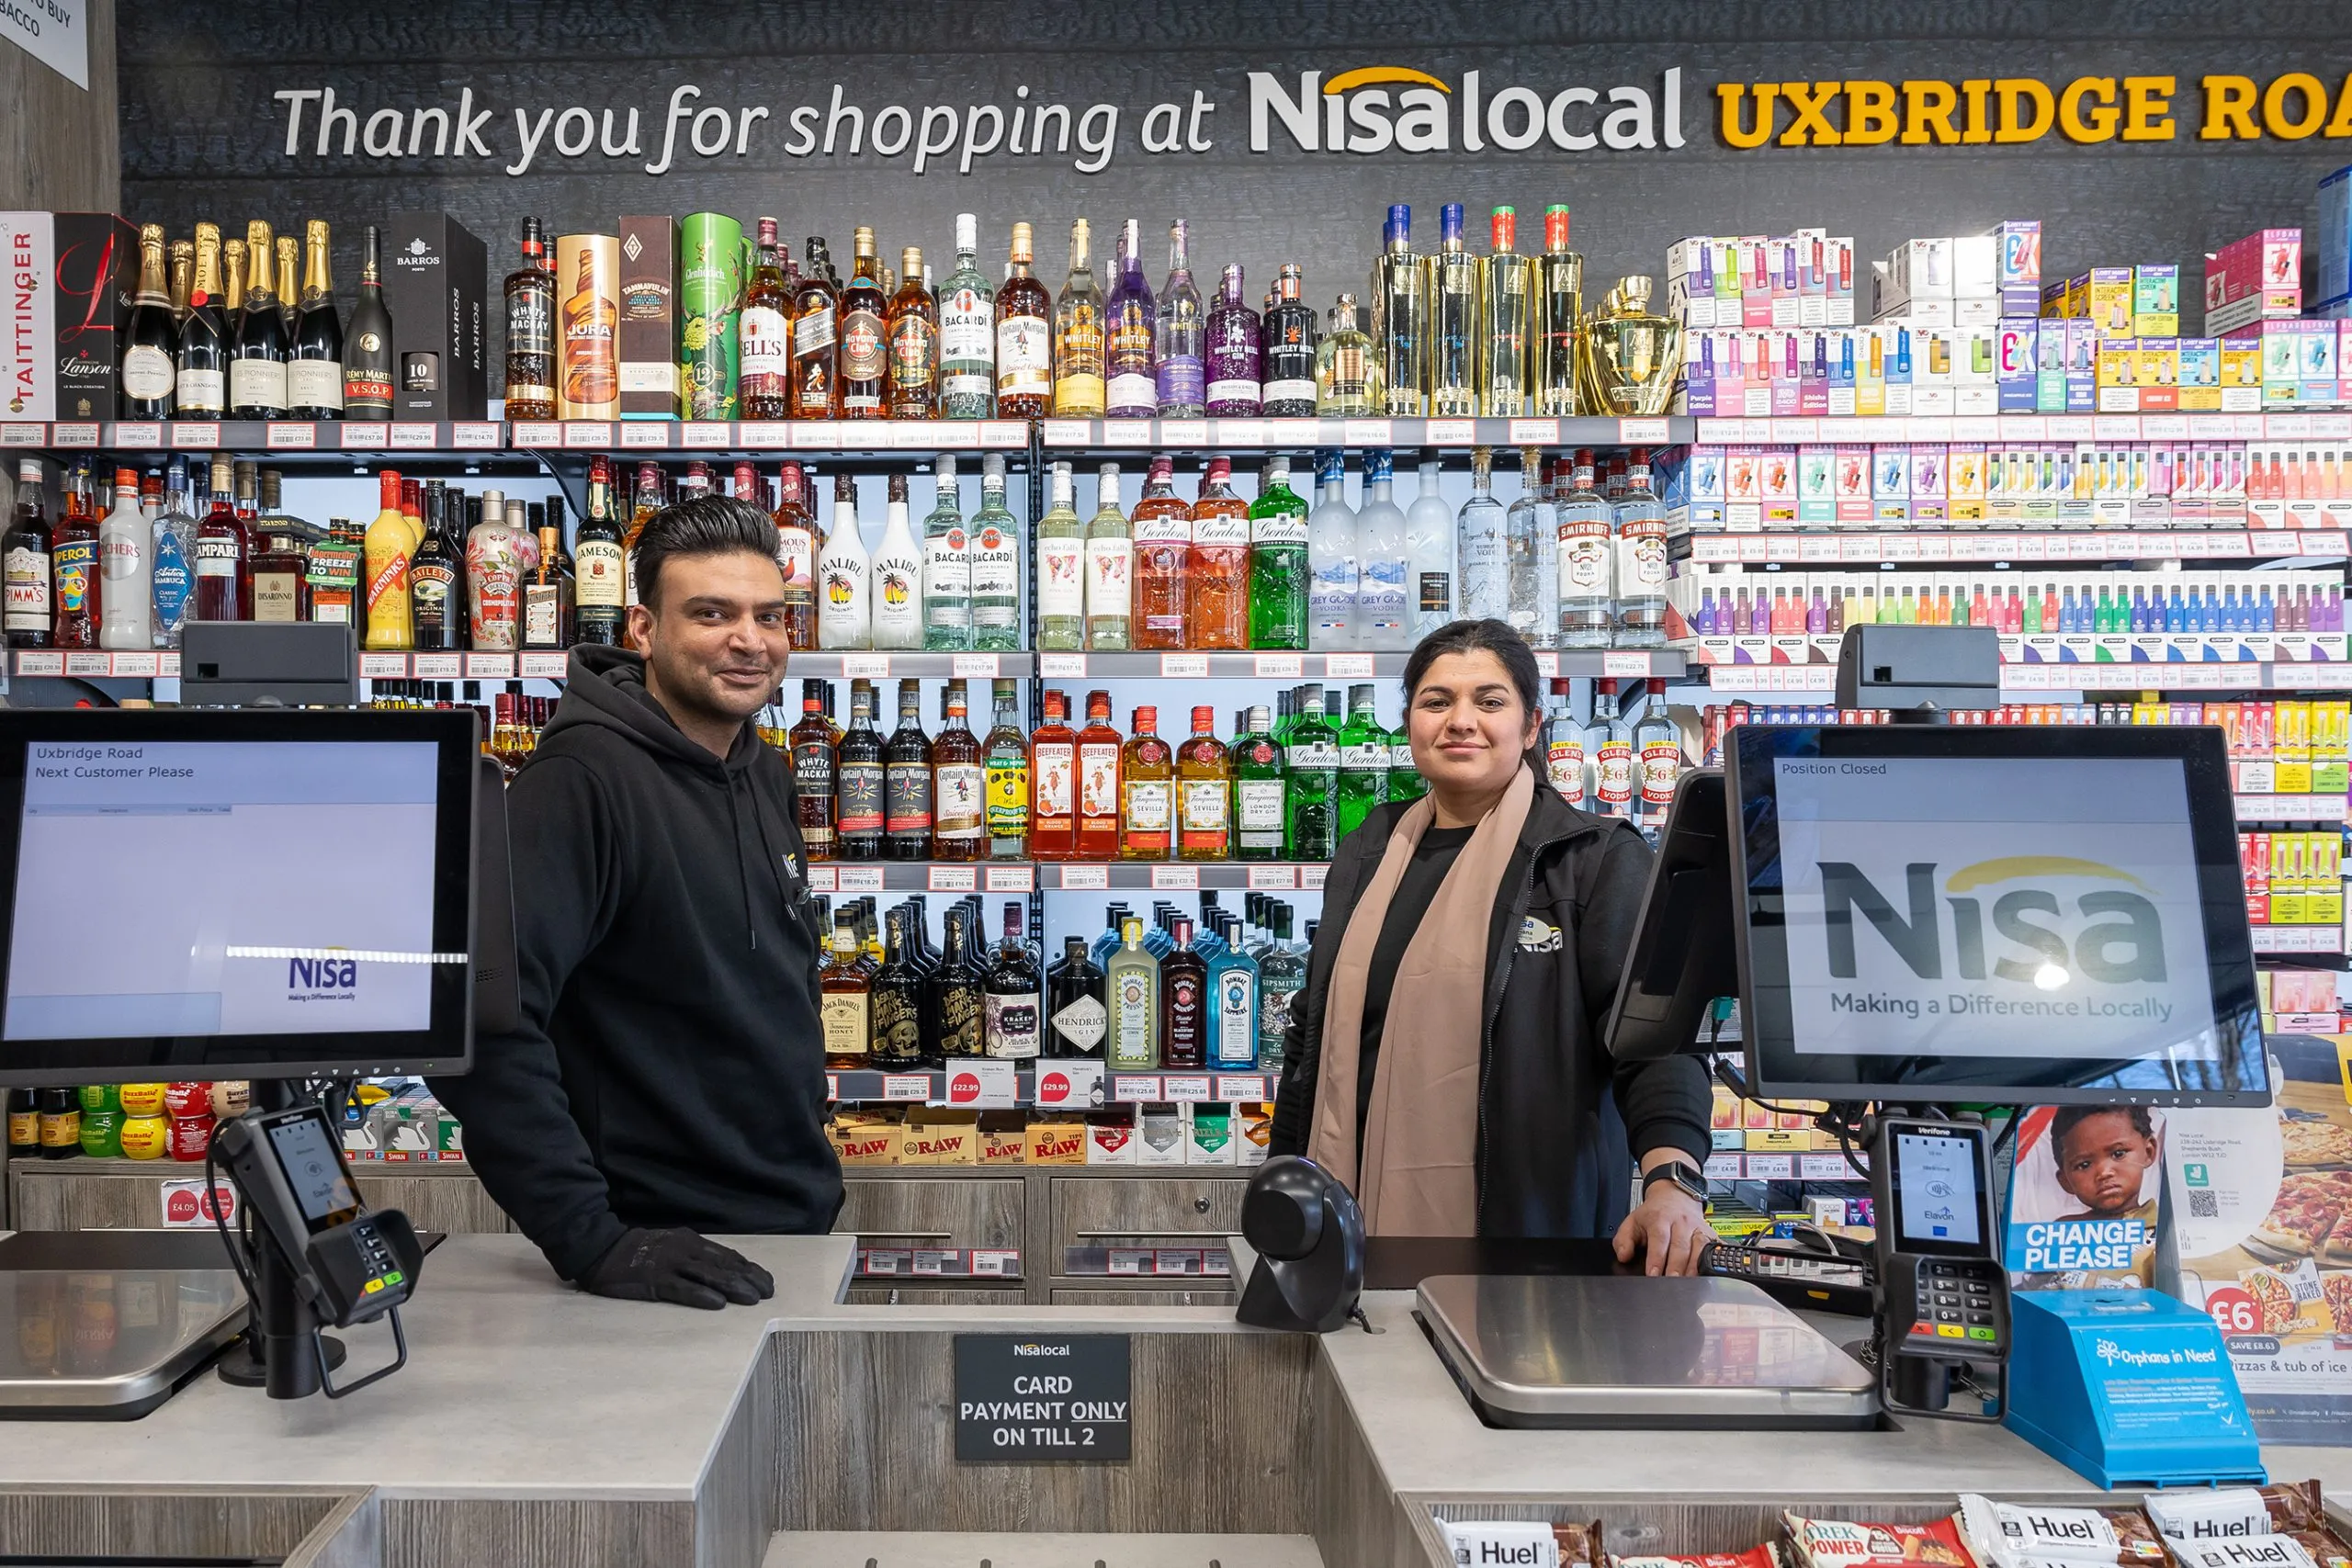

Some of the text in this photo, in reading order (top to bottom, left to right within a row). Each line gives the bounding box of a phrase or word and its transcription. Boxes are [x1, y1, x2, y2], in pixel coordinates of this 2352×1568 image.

[48, 6, 71, 28] BUY
[274, 86, 492, 158] Thank
[505, 107, 641, 176] you
[645, 85, 769, 175] for
[785, 84, 1119, 175] shopping
[1141, 90, 1215, 153] at
[1717, 75, 2176, 149] UXBRIDGE
[397, 256, 440, 266] BARROS
[622, 282, 670, 298] TAMNAVULIN
[14, 232, 35, 401] TAITTINGER
[511, 306, 548, 321] WHYTE
[510, 320, 548, 332] MACKAY
[567, 324, 612, 337] JURA
[845, 333, 879, 345] Havana
[1064, 333, 1102, 345] WHITLEY
[1113, 333, 1150, 345] WHITLEY
[741, 338, 782, 358] BELL'S
[851, 342, 871, 354] Club
[1215, 345, 1240, 355] WHITLEY
[1269, 345, 1294, 354] WHITLEY
[59, 356, 111, 378] Lanson
[410, 365, 428, 378] 10
[695, 367, 710, 380] 12
[1690, 394, 1713, 403] Purple
[1804, 393, 1826, 401] Shisha
[1804, 401, 1827, 410] Edition
[1560, 525, 1610, 539] SMIRNOFF
[575, 546, 622, 561] JAMESON
[311, 558, 354, 568] FREEZE
[820, 557, 864, 579] MALIBU
[876, 557, 919, 579] MALIBU
[311, 566, 352, 575] TO WIN
[411, 566, 455, 582] BAILEYS
[487, 572, 511, 582] COPPA
[367, 556, 407, 608] WARNINKS
[6, 585, 45, 604] PIMM'S
[258, 593, 293, 602] DISARONNO
[1309, 595, 1357, 605] GREY GOOSE
[1362, 595, 1380, 605] GREY
[482, 599, 515, 607] COSMOPOLITAN
[828, 604, 854, 614] ORIGINAL
[37, 747, 143, 761] Uxbridge Road
[1037, 747, 1072, 759] BEEFEATER
[1081, 747, 1116, 759] BEEFEATER
[1550, 749, 1583, 760] GLEN'S
[1600, 749, 1632, 760] GLEN'S
[1644, 749, 1679, 760] GLEN'S
[797, 757, 830, 770] WHYTE
[1782, 761, 1887, 776] Position Closed
[35, 766, 194, 778] Next Customer Please
[797, 769, 831, 780] MACKAY
[839, 768, 884, 781] Captain Morgan
[1603, 792, 1631, 802] VODKA
[1136, 805, 1163, 813] SEVILLA
[1193, 805, 1220, 813] SEVILLA
[1815, 856, 2167, 985] Nisa
[289, 956, 356, 988] Nisa
[1123, 977, 1144, 990] BOMBAY
[1225, 974, 1249, 987] BOMBAY
[1261, 979, 1305, 987] SIPSMITH
[875, 988, 896, 1007] DEAD
[823, 998, 861, 1013] JACK DANIEL'S
[876, 999, 901, 1017] MAN'S
[1831, 992, 2173, 1023] Making a Difference Locally
[876, 1008, 919, 1029] FINGERS
[1003, 1015, 1034, 1023] KRAKEN
[1078, 1028, 1095, 1036] GIN
[953, 1083, 979, 1093] £22.99
[1043, 1082, 1069, 1092] £29.99
[1069, 1133, 1083, 1141] TIPS
[1918, 1126, 1951, 1138] Verifone
[842, 1139, 889, 1157] RAW
[918, 1136, 963, 1156] RAW
[985, 1142, 1023, 1159] RAW
[1035, 1138, 1082, 1157] RAW
[388, 1152, 406, 1160] SWAN
[442, 1152, 460, 1160] SWAN
[172, 1202, 195, 1213] £4.05
[1924, 1210, 1955, 1223] Elavon
[2026, 1221, 2143, 1247] CHANGE
[2025, 1245, 2130, 1271] PLEASE
[2295, 1280, 2319, 1294] STONE
[2298, 1289, 2321, 1301] BAKED
[2212, 1301, 2255, 1332] £6
[2230, 1341, 2276, 1352] SAVE £8.63
[2121, 1348, 2217, 1367] Orphans in Need
[2270, 1359, 2280, 1372] &
[2284, 1359, 2307, 1372] tub
[2312, 1359, 2325, 1372] of
[2328, 1359, 2347, 1372] ice
[1013, 1376, 1073, 1395] CARD
[960, 1401, 1127, 1422] PAYMENT ONLY
[992, 1427, 1095, 1446] ON TILL 2
[2028, 1516, 2095, 1540] Huel
[2193, 1516, 2251, 1539] Huel
[1804, 1526, 1855, 1544] TREK
[1480, 1540, 1538, 1565] Huel
[1808, 1540, 1865, 1558] POWER
[1871, 1543, 1902, 1554] PROTEIN
[2224, 1541, 2291, 1564] Huel
